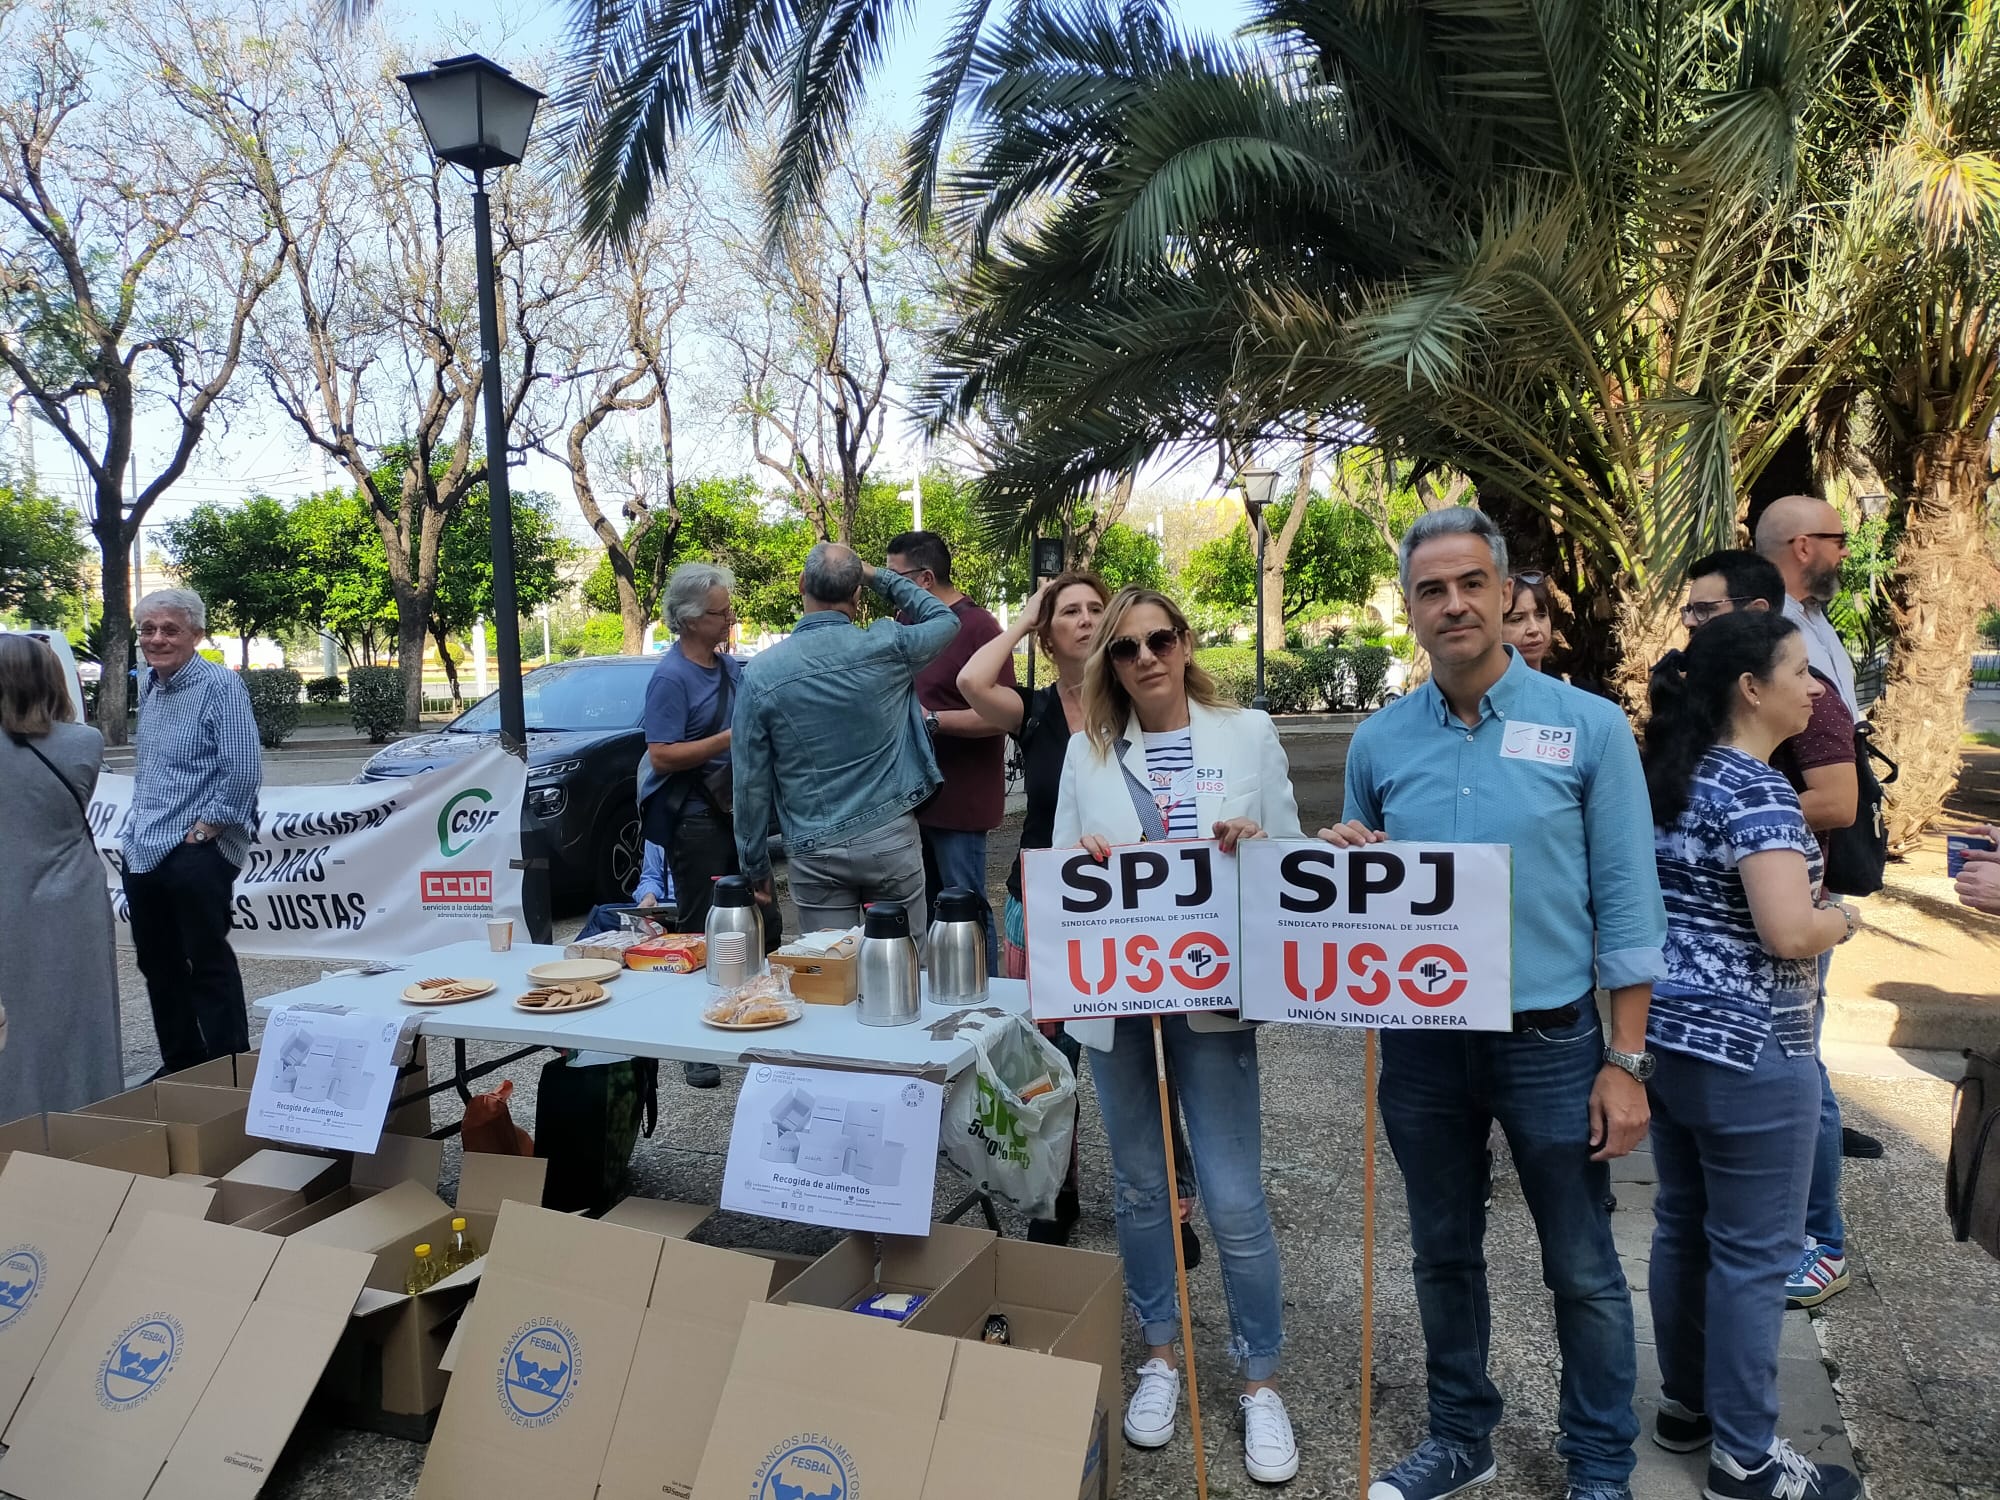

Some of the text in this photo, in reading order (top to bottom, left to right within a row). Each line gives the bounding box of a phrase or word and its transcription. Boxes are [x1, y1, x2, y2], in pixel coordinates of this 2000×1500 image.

[1538, 729, 1572, 744] SPJ
[1536, 743, 1571, 759] USO
[1196, 768, 1223, 779] SPJ
[1196, 781, 1225, 792] USO
[451, 809, 501, 834] CSIF
[243, 845, 331, 884] CLARAS
[425, 876, 491, 897] CCOO
[1061, 847, 1213, 913] SPJ
[1279, 848, 1455, 916] SPJ
[267, 892, 367, 931] JUSTAS
[422, 903, 451, 911] servicios
[1061, 912, 1219, 928] SINDICATO PROFESIONAL DE JUSTICIA
[1278, 919, 1459, 931] SINDICATO PROFESIONAL DE JUSTICIA
[1067, 931, 1231, 996] USO
[1283, 940, 1468, 1008] USO
[1073, 995, 1233, 1014] UNIÓN SINDICAL OBRERA
[1287, 1008, 1468, 1026] UNIÓN SINDICAL OBRERA
[276, 1101, 344, 1118] Recogida de alimentos
[772, 1173, 871, 1195] Recogida de alimentos
[7, 1260, 33, 1273] FESBAL
[111, 1313, 152, 1348] BANCOS
[139, 1329, 168, 1344] FESBAL
[502, 1318, 538, 1355] BANCOS
[529, 1336, 562, 1354] FESBAL
[495, 1368, 513, 1416] BANCOS
[754, 1432, 860, 1500] BANCOS DE ALIMENTOS
[790, 1455, 833, 1475] FESBAL
